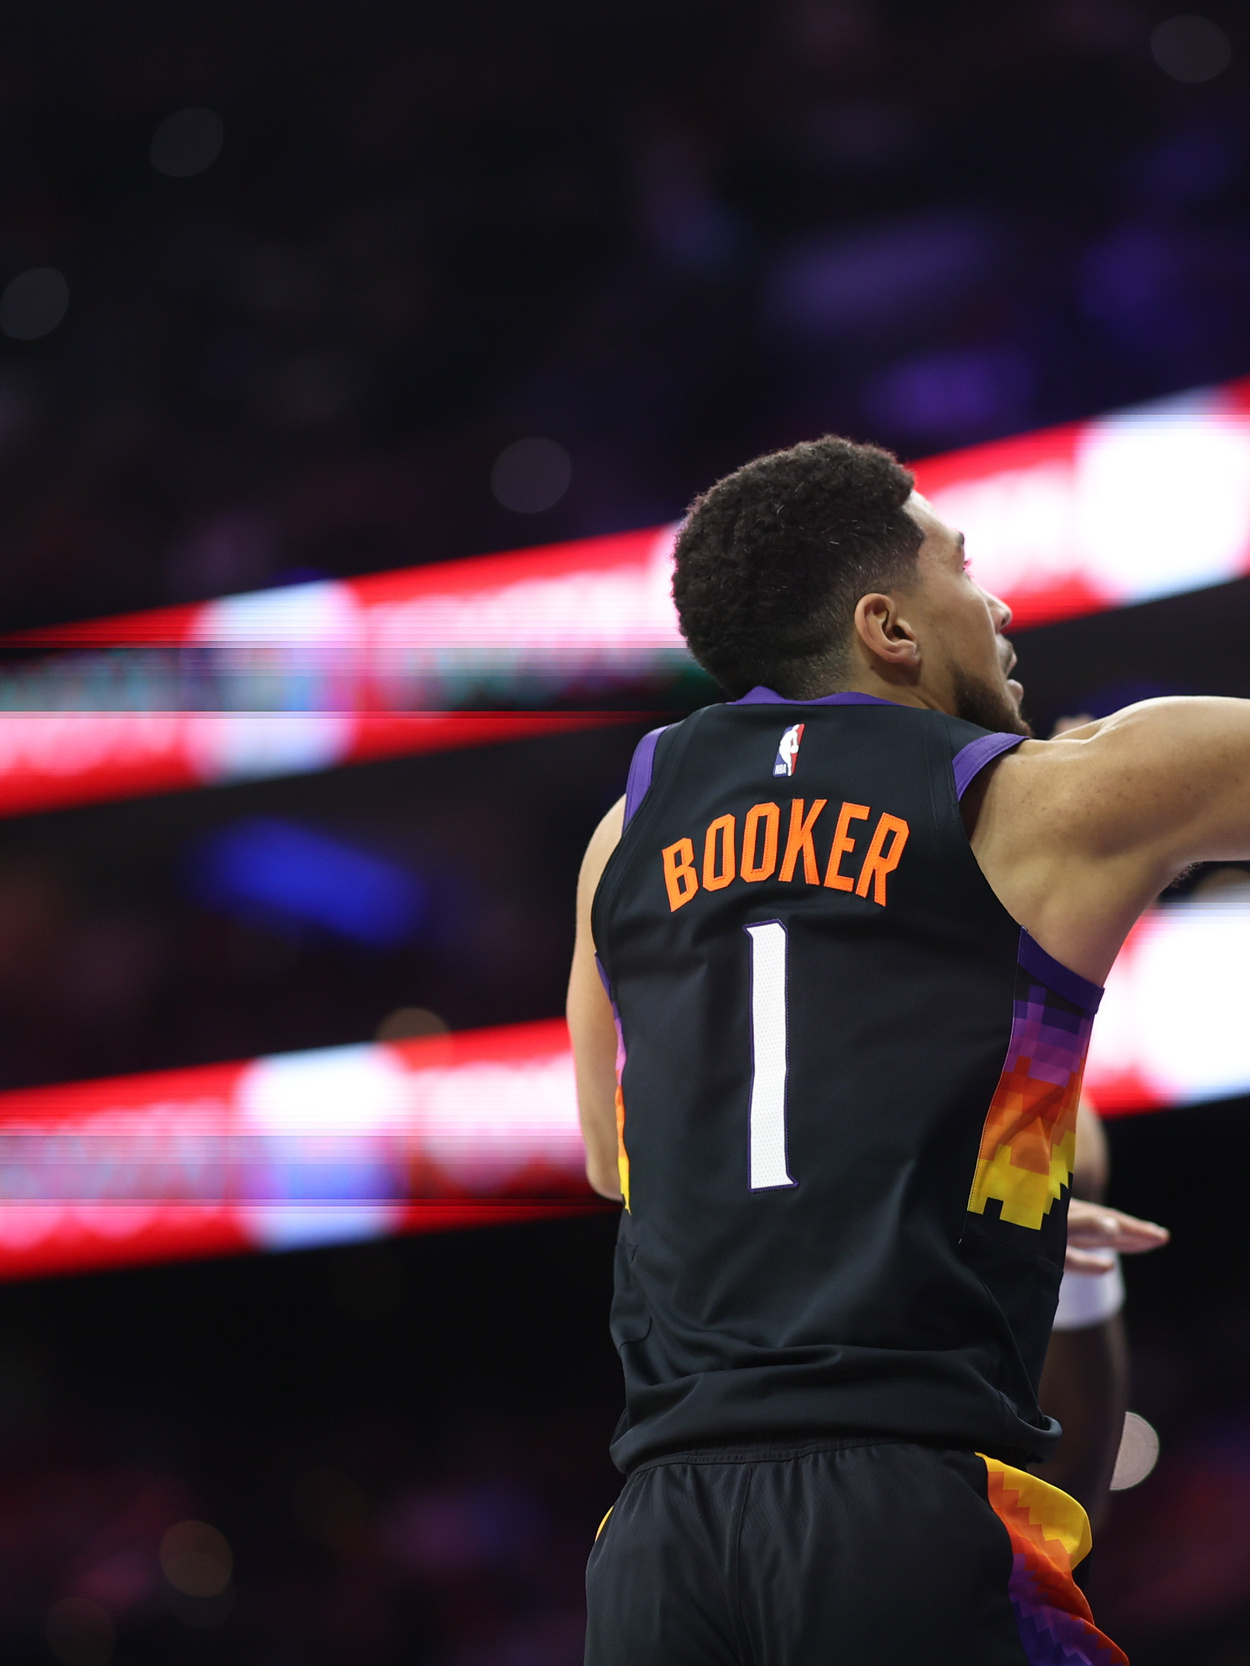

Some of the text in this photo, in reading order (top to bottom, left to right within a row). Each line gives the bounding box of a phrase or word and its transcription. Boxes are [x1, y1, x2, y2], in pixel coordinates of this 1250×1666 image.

[774, 763, 787, 775] NBA
[661, 798, 910, 913] BOOKER
[743, 918, 799, 1194] 1
